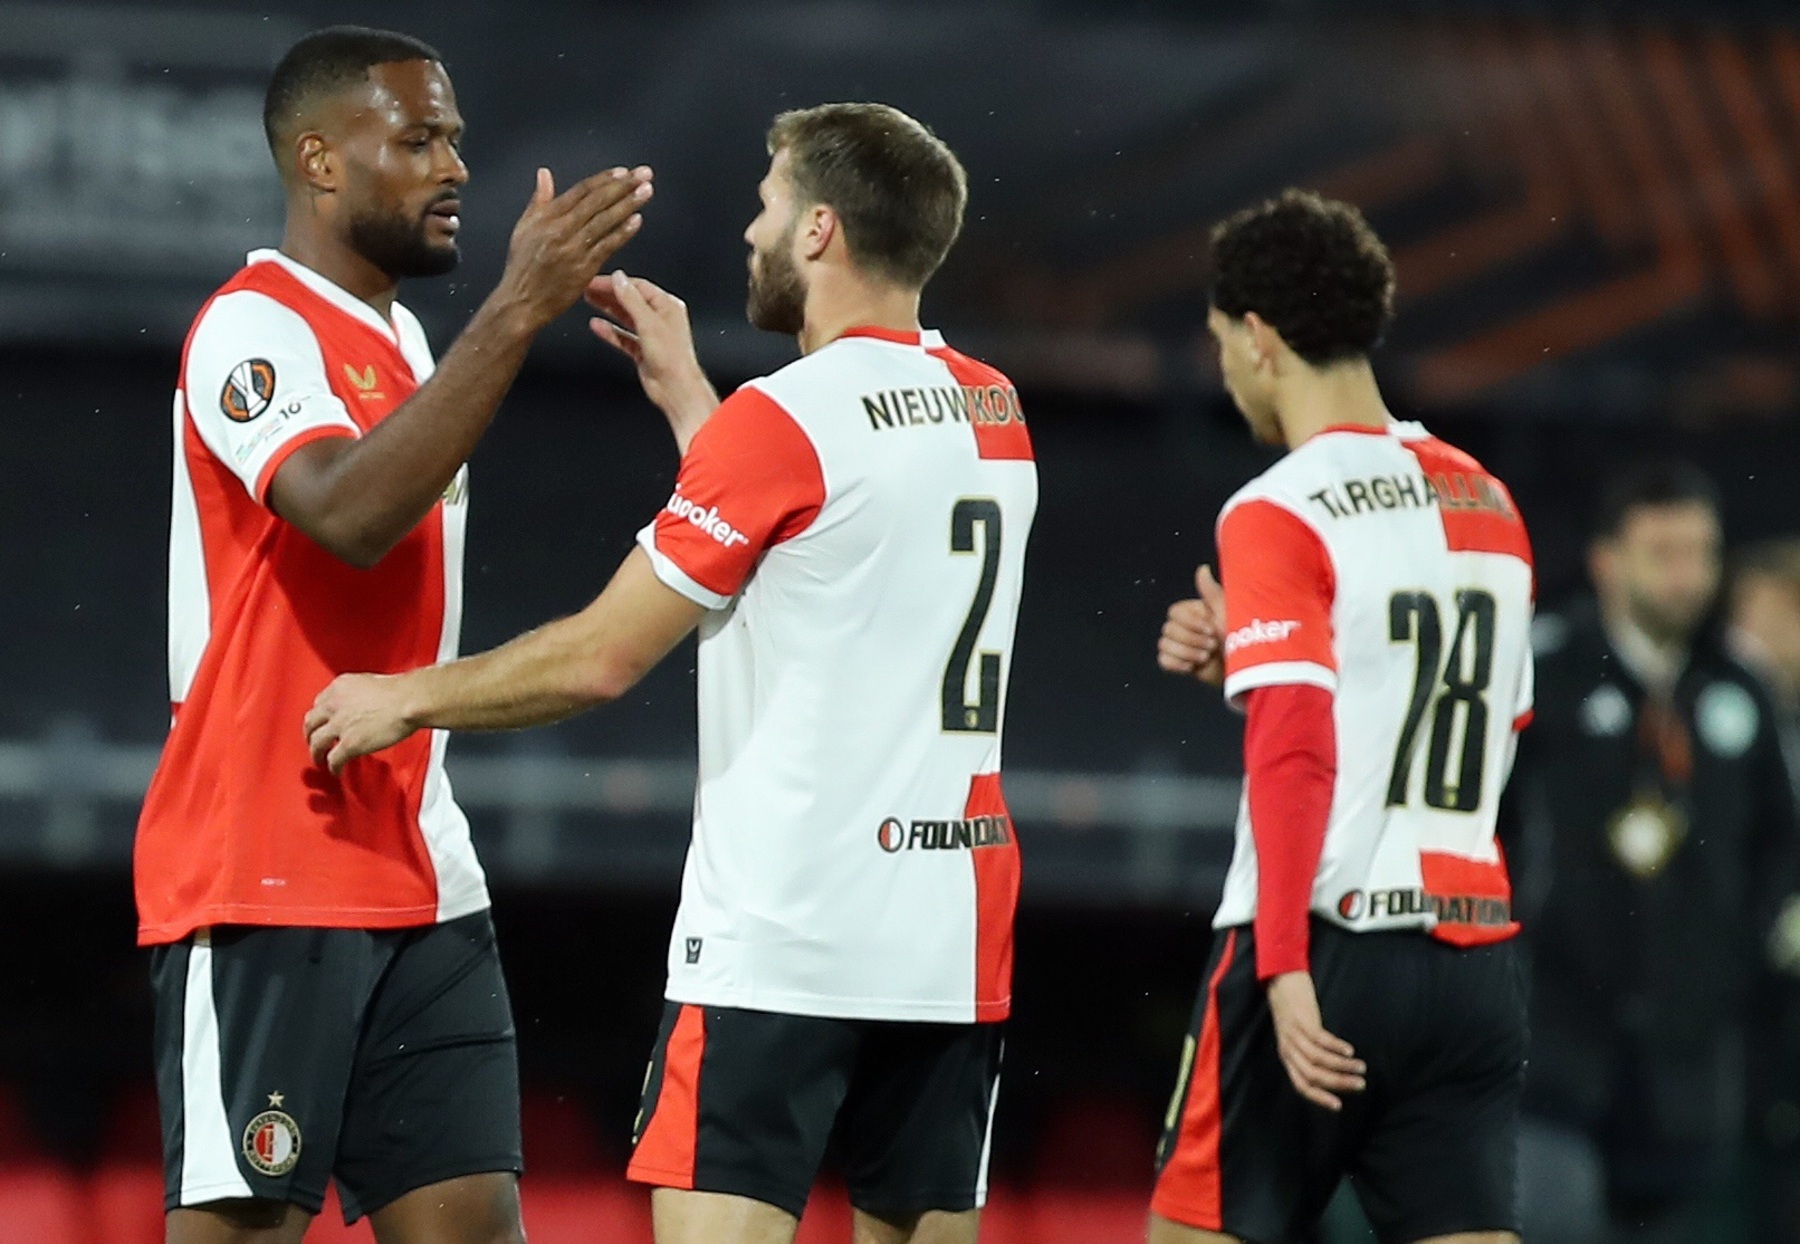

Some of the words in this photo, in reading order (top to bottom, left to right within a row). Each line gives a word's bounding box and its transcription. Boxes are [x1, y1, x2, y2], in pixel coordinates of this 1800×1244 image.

[667, 482, 749, 547] uooker
[941, 495, 1001, 737] 2
[1225, 618, 1301, 655] ooker
